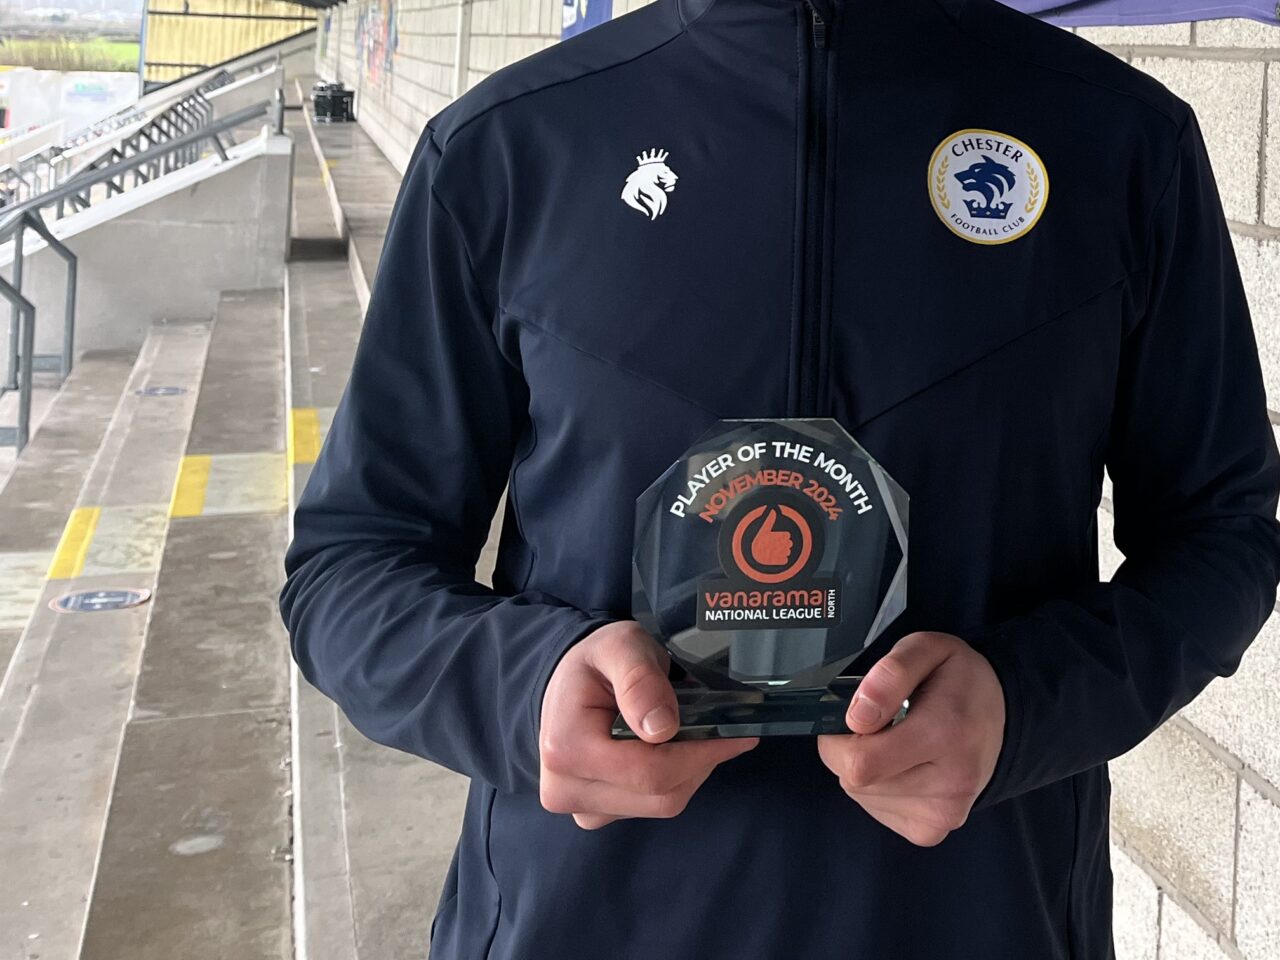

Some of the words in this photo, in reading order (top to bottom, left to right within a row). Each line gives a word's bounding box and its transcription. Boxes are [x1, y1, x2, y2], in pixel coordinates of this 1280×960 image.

[951, 137, 1024, 163] CHESTER
[950, 213, 999, 235] FOOTBALL
[1002, 216, 1025, 233] CLUB
[669, 453, 736, 518] PLAYER
[737, 442, 767, 462] OF
[771, 441, 814, 464] THE
[813, 452, 873, 515] MONTH
[699, 469, 804, 523] NOVEMBER
[802, 479, 844, 521] 2024
[705, 589, 823, 608] vanarama
[827, 589, 836, 618] NORTH
[705, 609, 769, 621] NATIONAL
[772, 608, 822, 619] LEAGUE
